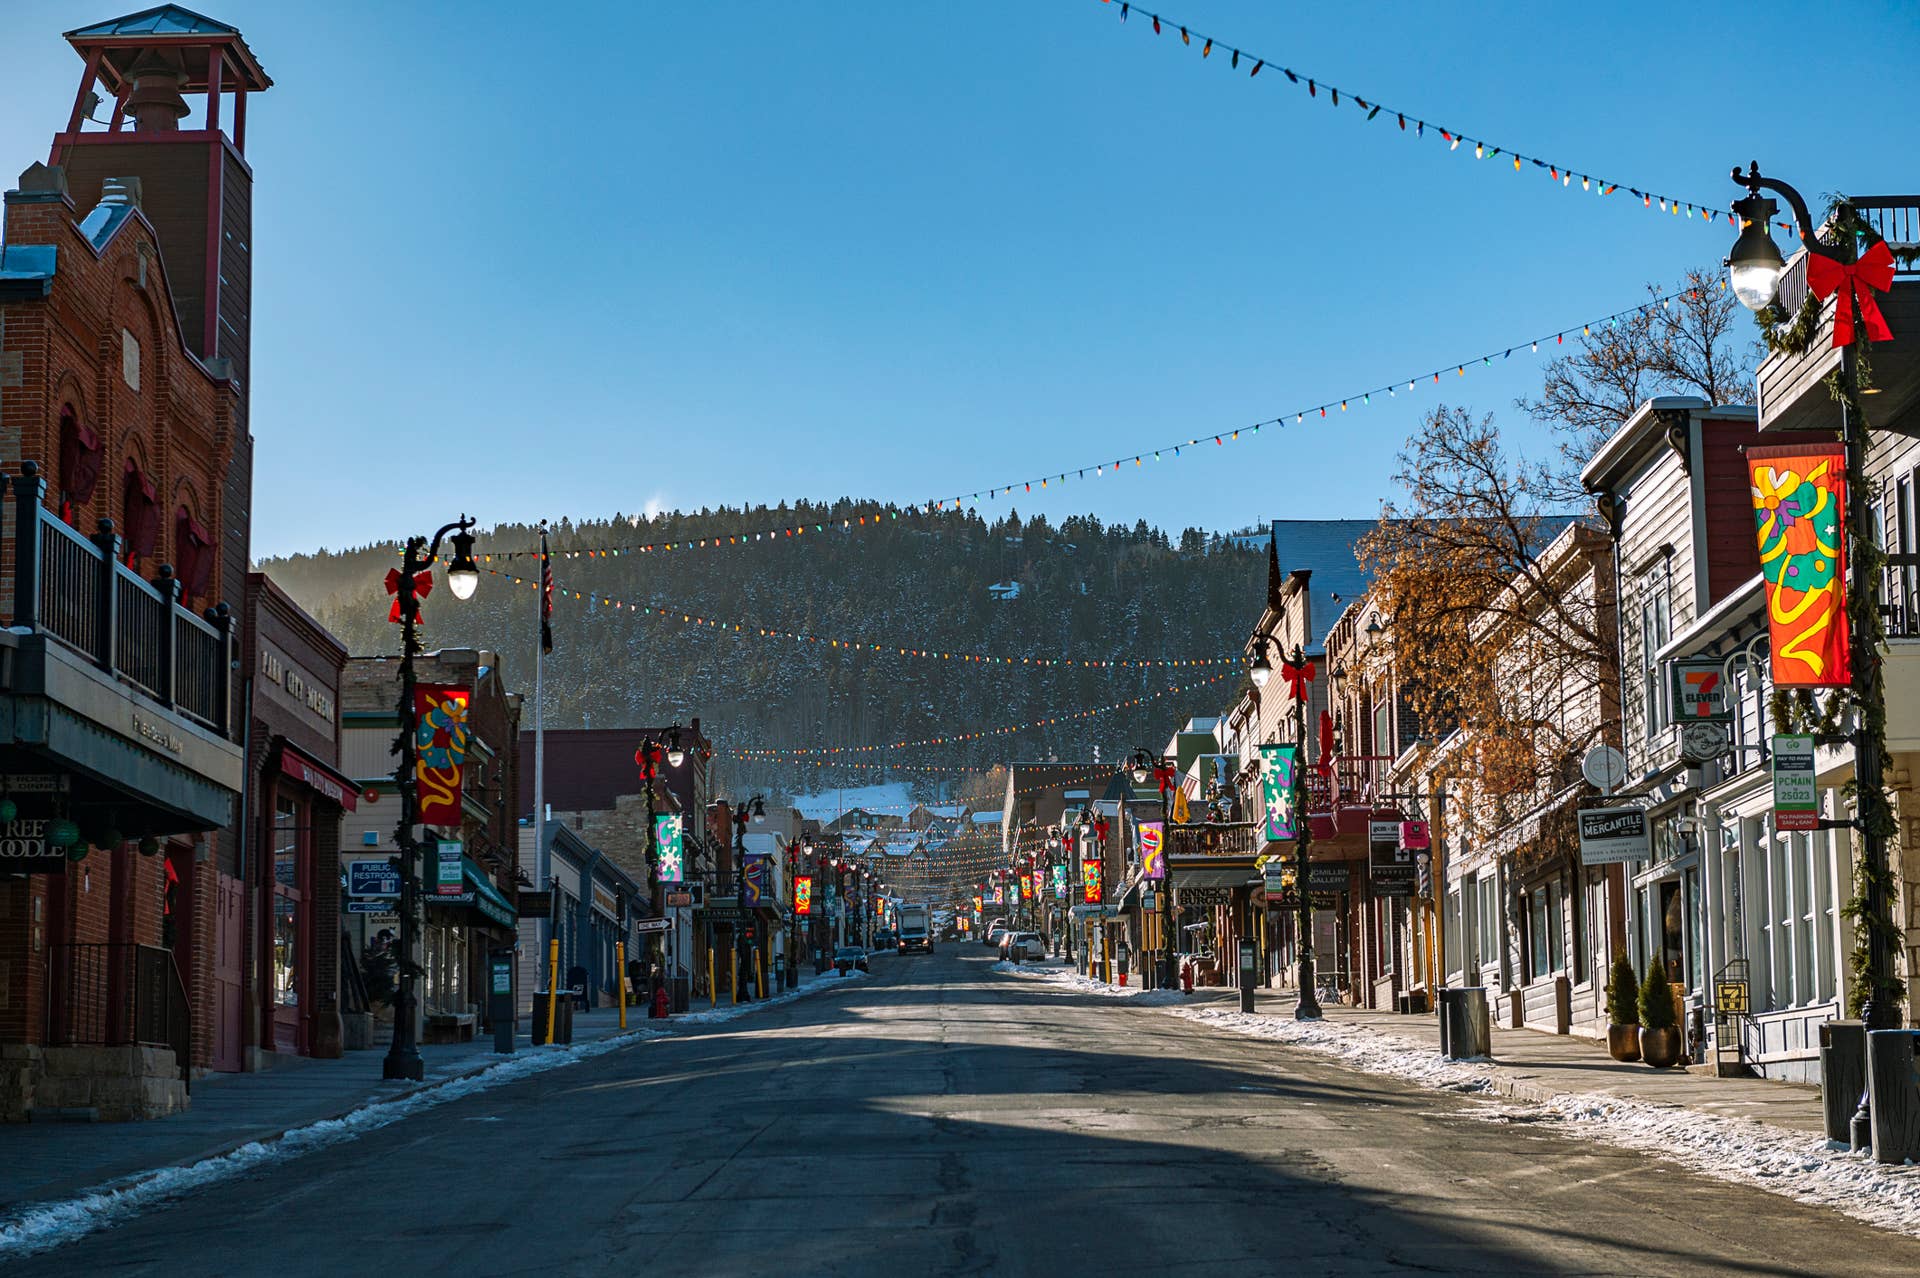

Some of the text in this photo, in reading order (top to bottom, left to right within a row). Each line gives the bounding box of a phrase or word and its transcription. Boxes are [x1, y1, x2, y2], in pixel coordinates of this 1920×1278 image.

[261, 651, 335, 724] PARK CITY MUSEUM
[1685, 672, 1718, 717] 7
[1786, 741, 1800, 750] GO
[1778, 778, 1812, 786] PCMAIN
[1782, 792, 1809, 800] 25023
[1584, 815, 1642, 837] MERCANTILE
